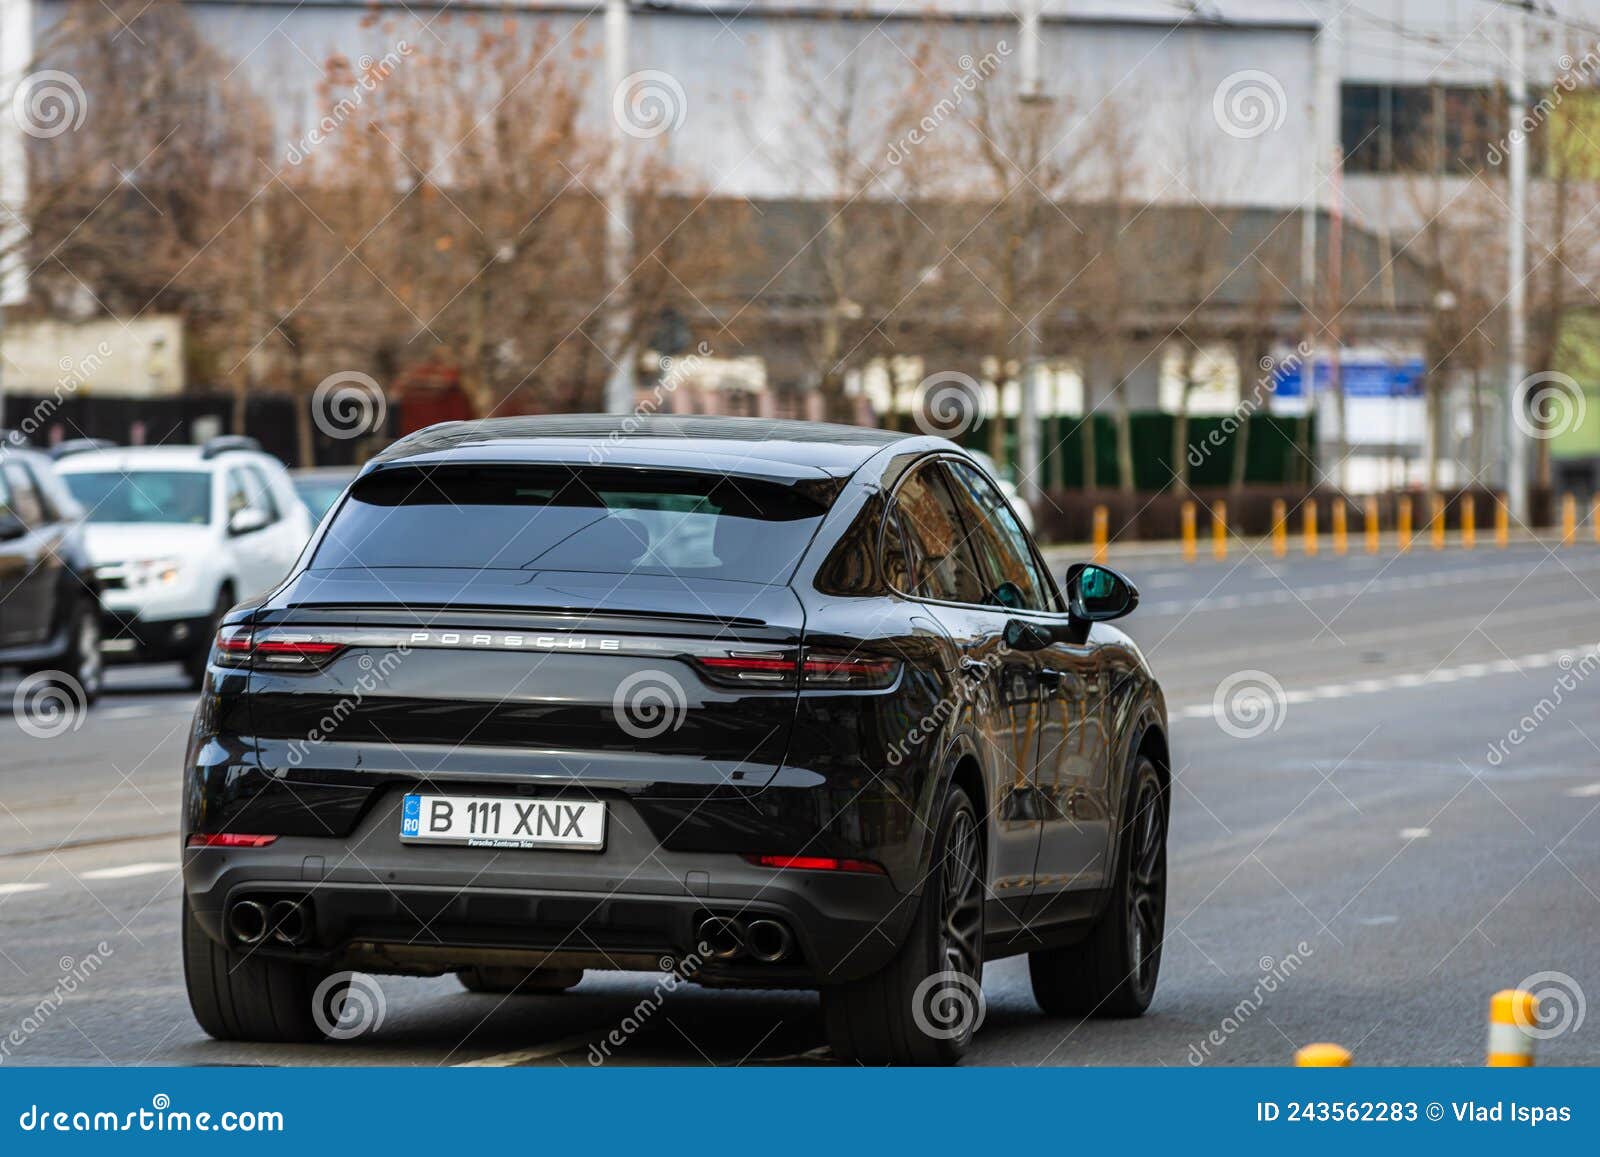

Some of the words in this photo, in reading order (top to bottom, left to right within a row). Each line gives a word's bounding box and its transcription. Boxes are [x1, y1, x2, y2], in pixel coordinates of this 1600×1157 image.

[411, 633, 620, 650] PORSCHE
[404, 818, 418, 832] RO
[430, 800, 454, 832] B
[467, 802, 502, 834] 111
[512, 803, 586, 837] XNX
